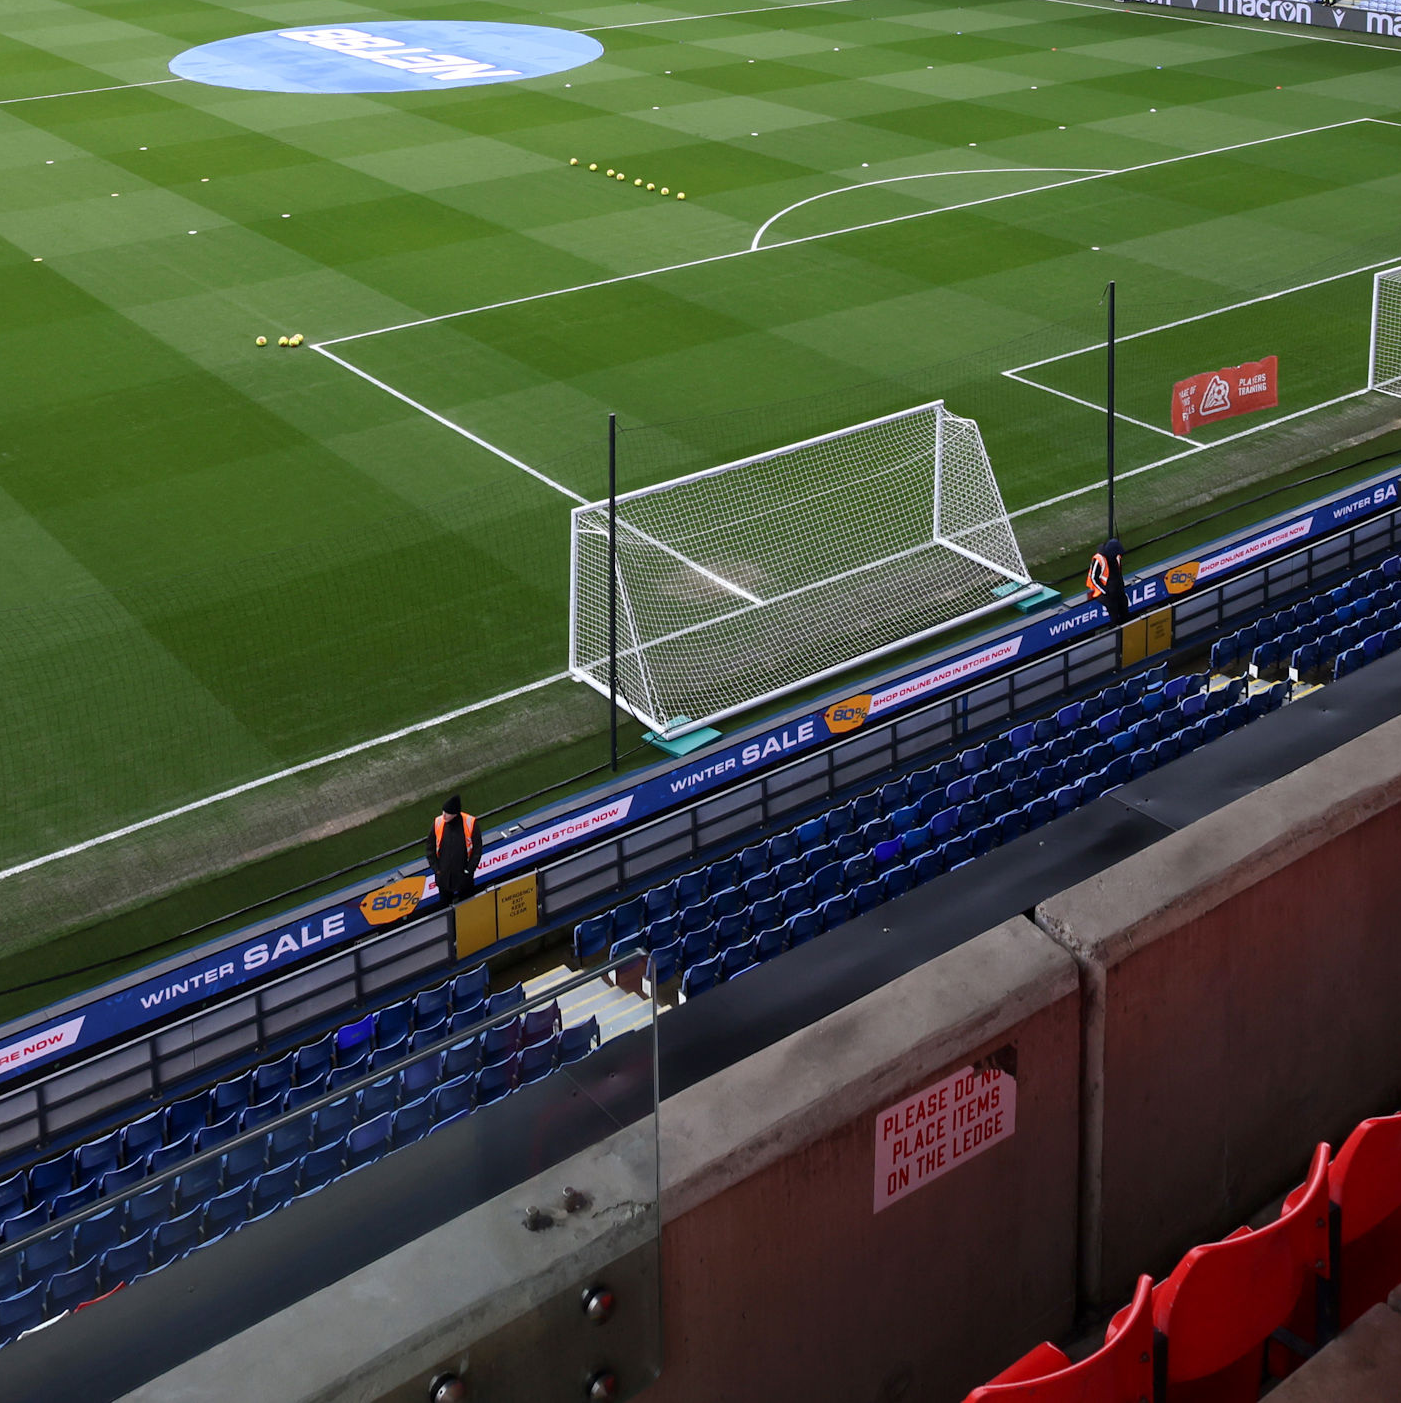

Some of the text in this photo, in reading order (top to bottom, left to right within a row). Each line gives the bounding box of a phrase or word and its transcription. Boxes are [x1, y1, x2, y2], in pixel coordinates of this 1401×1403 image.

[1238, 373, 1266, 386] PLAYERS
[1238, 382, 1267, 396] TRAINING
[1333, 483, 1397, 519] WINTER SA
[1200, 525, 1305, 573] SHOP ONLINE AND IN STORE NOW
[1170, 571, 1197, 584] 80%
[1049, 610, 1098, 637] WINTER
[873, 645, 1012, 707] SHOP ONLINE AND IN STORE NOW
[833, 707, 867, 722] 80%
[670, 720, 814, 793] WINTER SALE
[474, 808, 619, 871] NLINE AND IN STORE NOW
[372, 891, 420, 911] 80%
[140, 912, 346, 1010] WINTER SALE
[23, 1033, 65, 1056] NOW
[884, 1087, 948, 1141] PLEASE
[955, 1074, 974, 1102] DO
[892, 1085, 1000, 1165] PLACE ITEMS
[887, 1111, 1004, 1197] ON THE LEDGE
